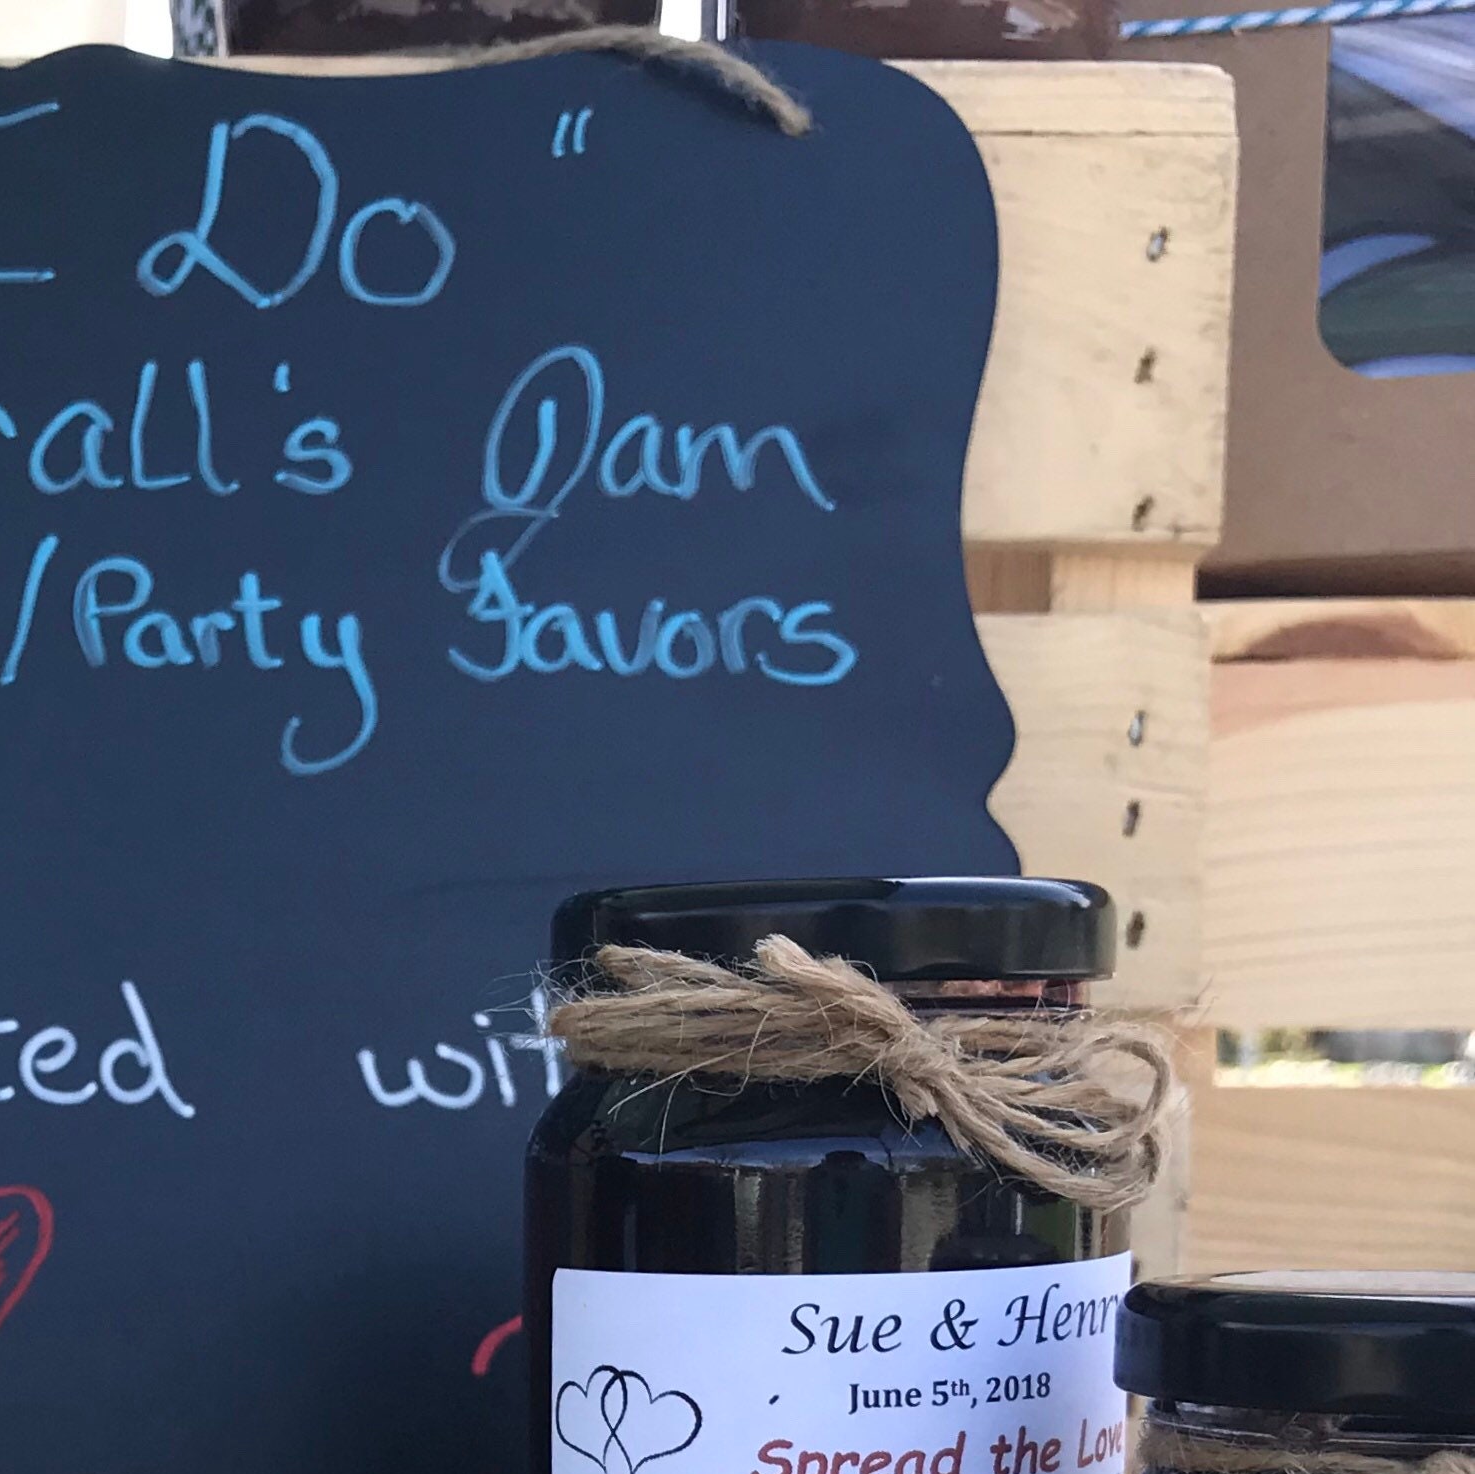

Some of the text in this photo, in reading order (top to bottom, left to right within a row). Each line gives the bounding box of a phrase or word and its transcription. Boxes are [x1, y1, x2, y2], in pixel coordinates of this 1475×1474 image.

[137, 113, 456, 309] Do
[437, 344, 834, 596] Jam
[448, 548, 857, 686] Favors
[357, 986, 568, 1109] wit
[780, 1282, 1120, 1355] Sue & Henr
[848, 1371, 1051, 1416] June 5th, 2018
